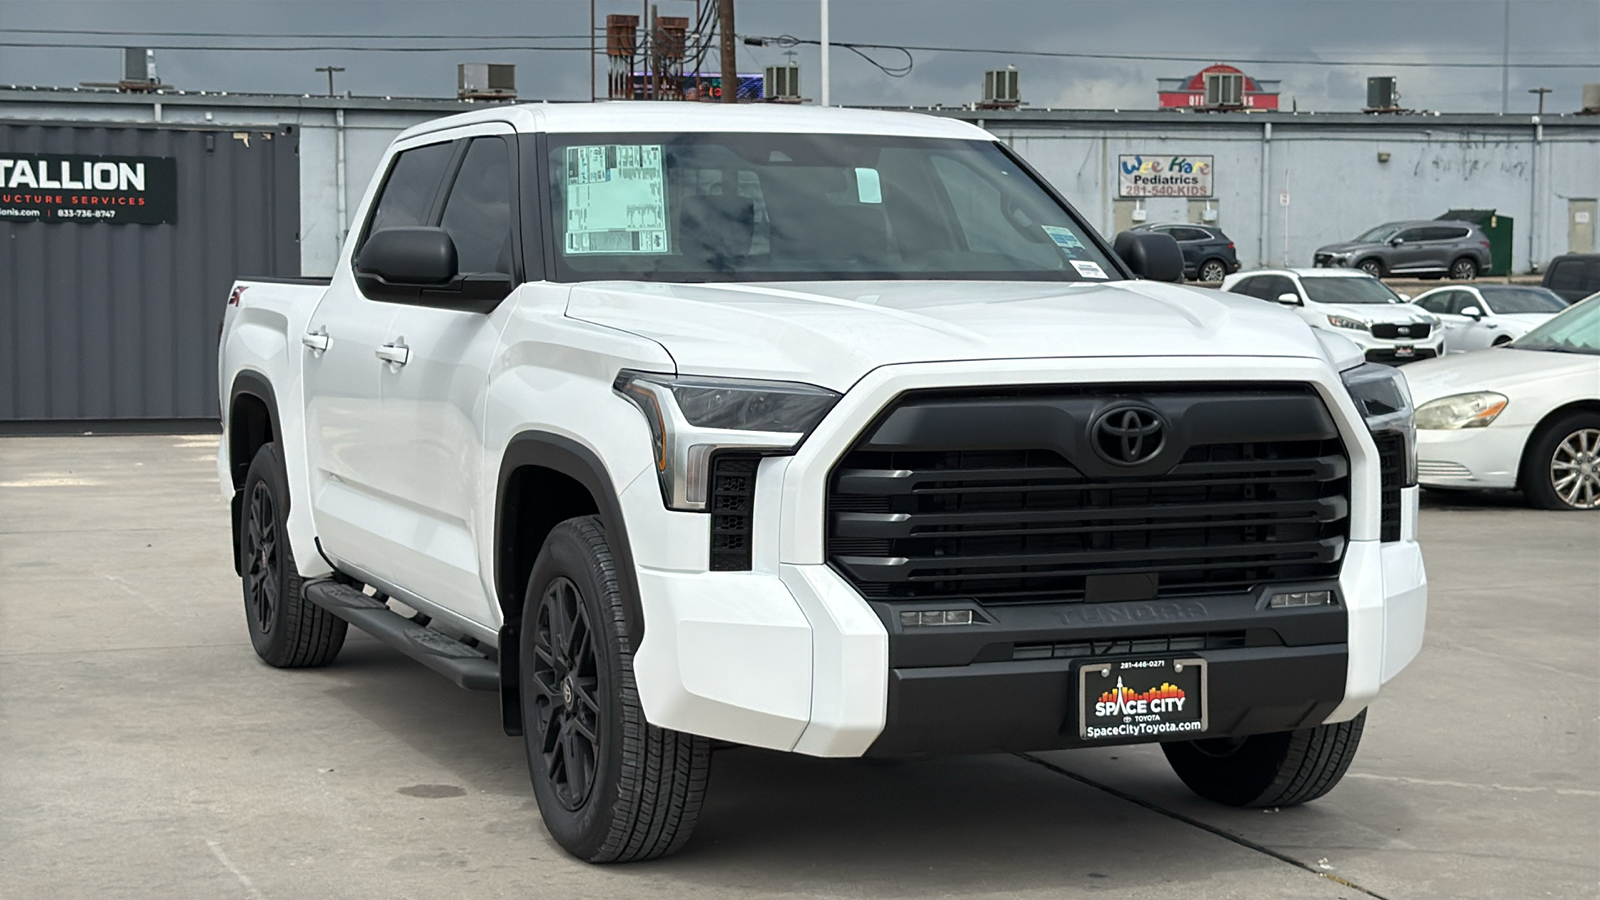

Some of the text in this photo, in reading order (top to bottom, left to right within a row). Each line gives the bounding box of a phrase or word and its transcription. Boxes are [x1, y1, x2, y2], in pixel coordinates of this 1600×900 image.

[1122, 155, 1210, 175] Wee Kare
[1134, 175, 1199, 185] Pediatrics
[1126, 185, 1207, 196] 281-540-KIDS
[3, 194, 146, 206] UCTURE SERVICES
[57, 209, 116, 218] 833-736-8747
[1054, 602, 1209, 625] TUNDRA
[1120, 660, 1165, 669] 281-446-0271
[1095, 697, 1186, 717] SPACE CITY
[1134, 715, 1161, 723] TOYOTA
[1087, 721, 1201, 738] SpaceCityToyota.com
